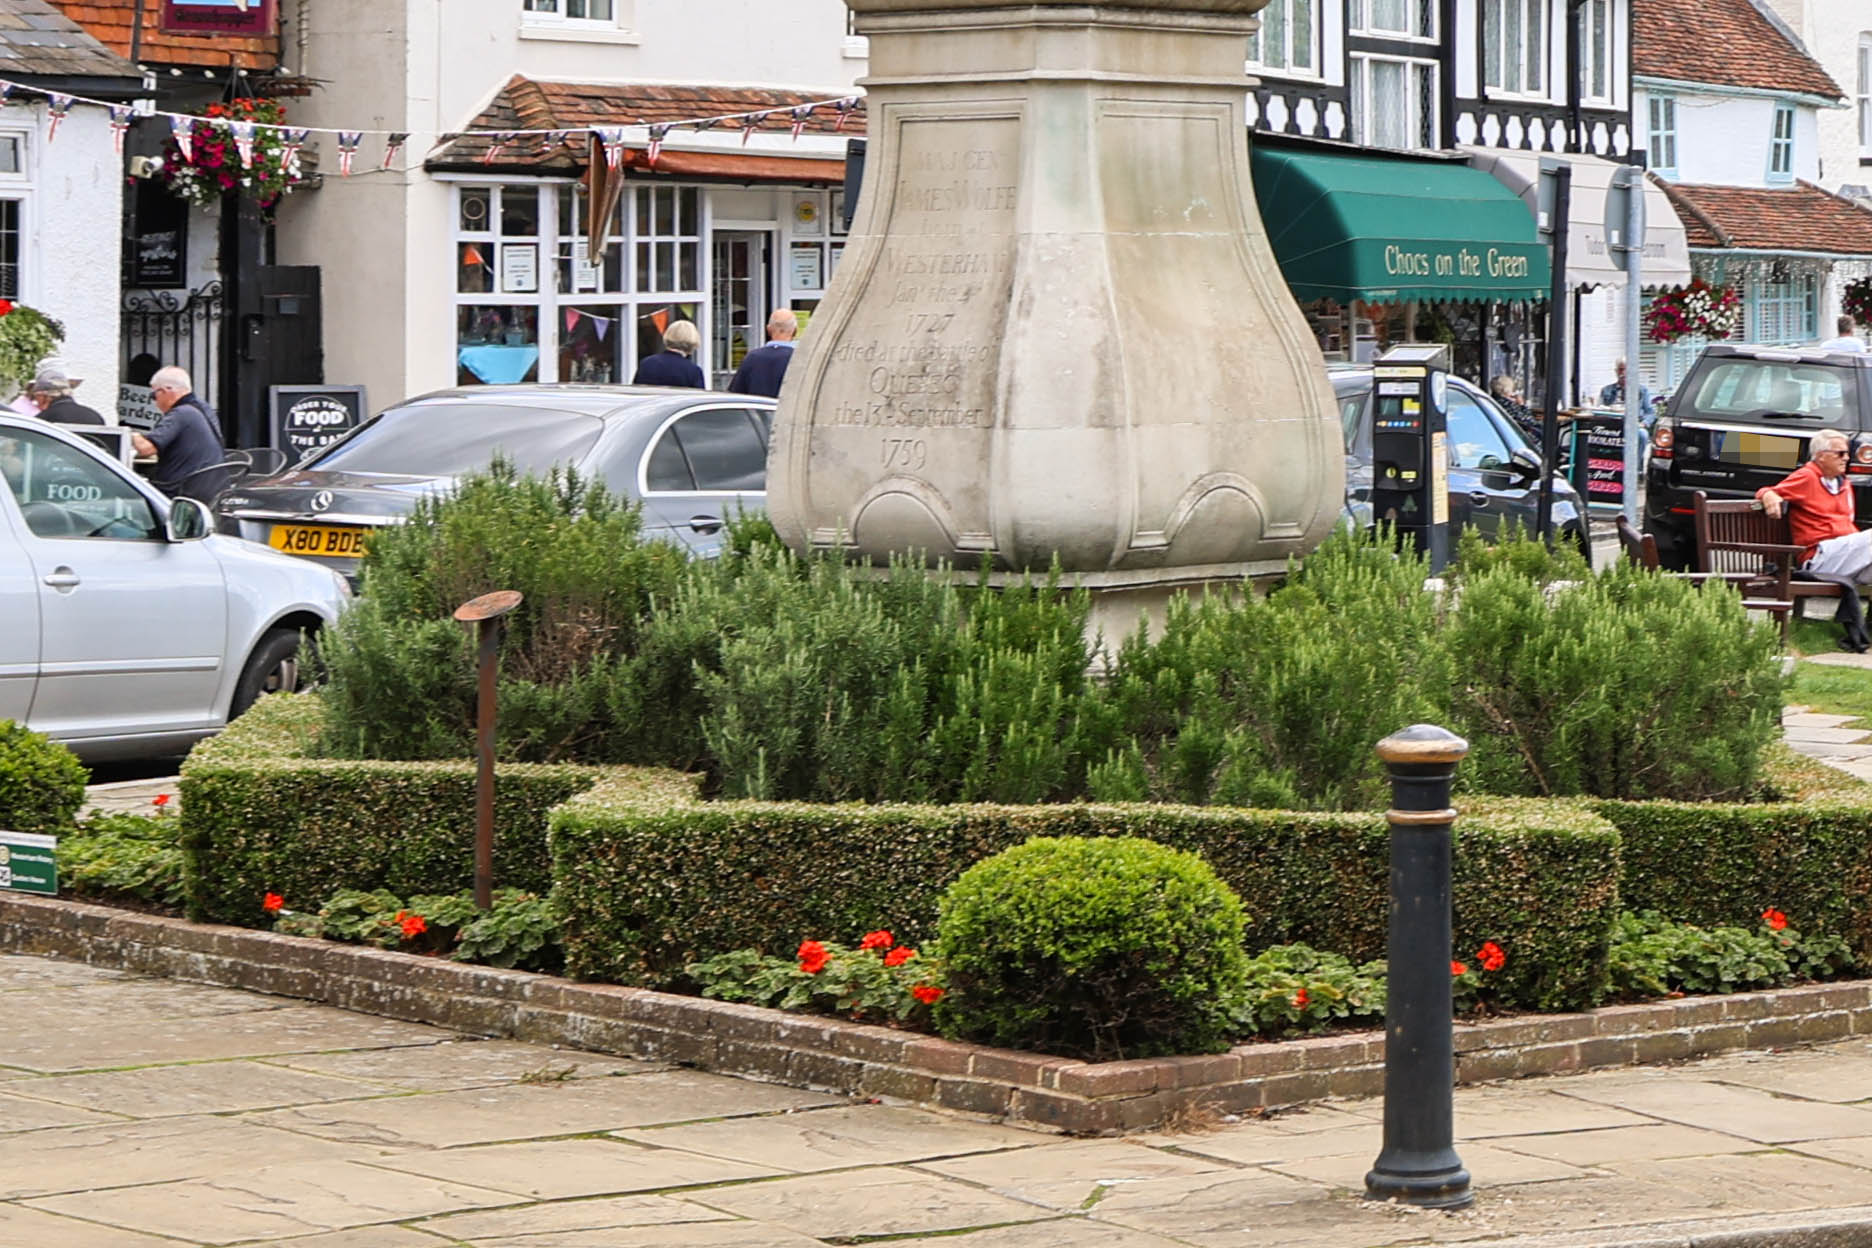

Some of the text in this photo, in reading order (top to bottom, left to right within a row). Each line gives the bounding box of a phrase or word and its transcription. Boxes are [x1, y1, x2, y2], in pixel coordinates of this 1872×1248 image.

[1385, 244, 1529, 278] Chocs on the Green
[120, 387, 152, 405] Beer
[119, 406, 162, 425] arden
[294, 410, 345, 426] FOOD
[290, 435, 315, 446] THE
[880, 438, 929, 472] 1759
[47, 483, 102, 502] FOOD
[283, 529, 322, 551] X80
